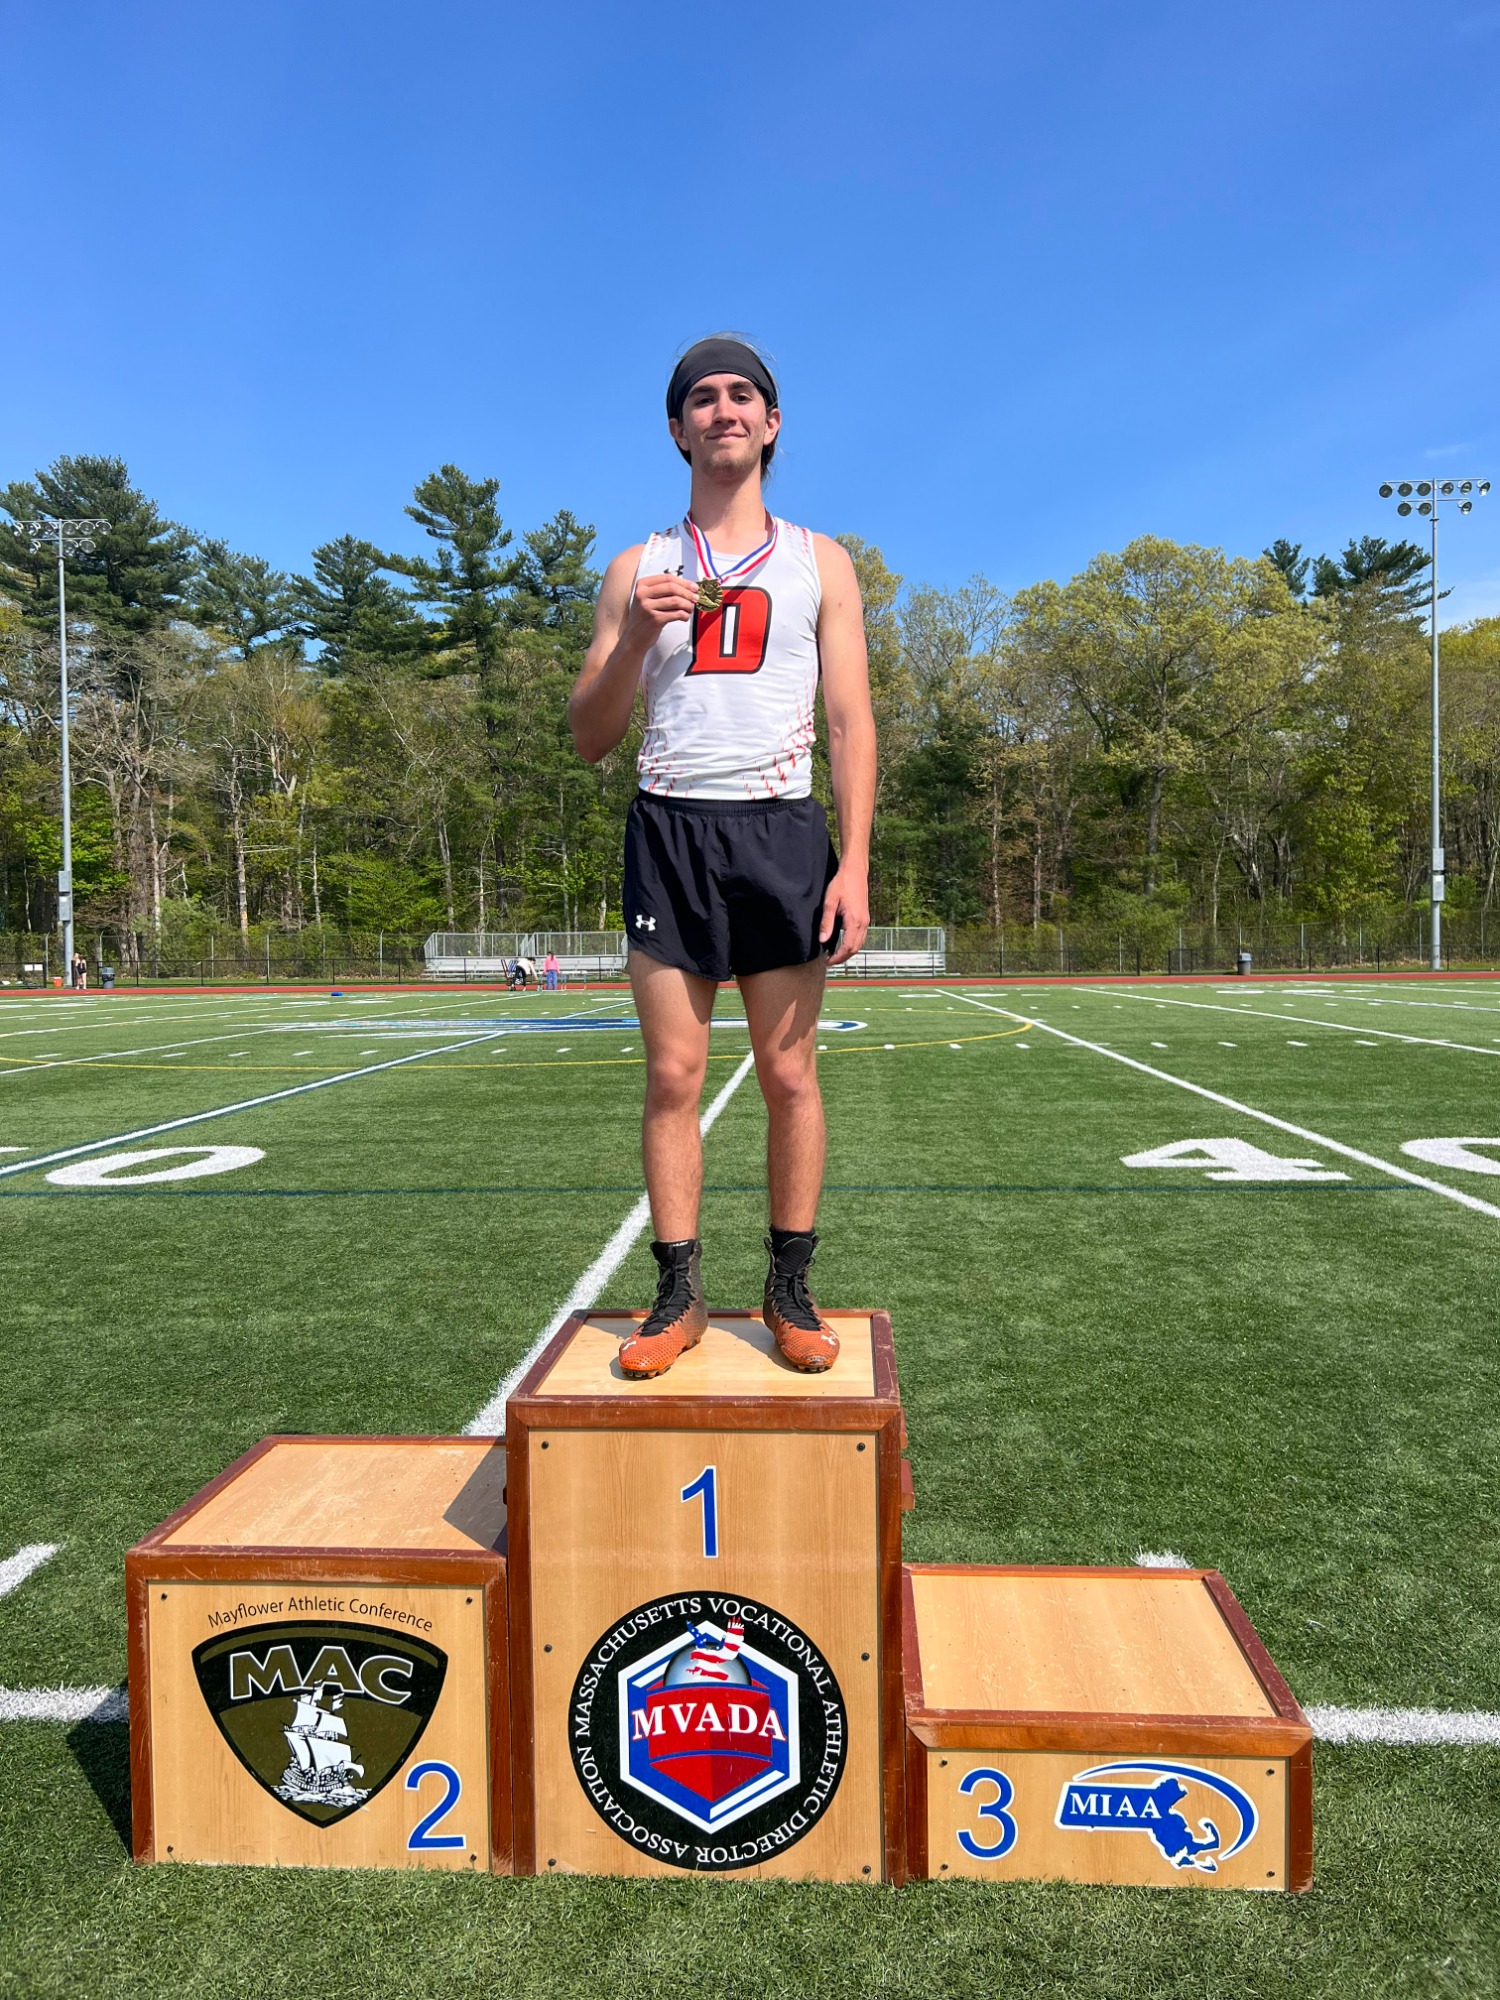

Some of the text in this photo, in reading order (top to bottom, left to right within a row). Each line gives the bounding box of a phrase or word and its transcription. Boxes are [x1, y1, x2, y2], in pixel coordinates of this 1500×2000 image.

[684, 586, 772, 677] D
[681, 1465, 718, 1558] 1
[208, 1595, 433, 1632] Mayflower Athletic Conference
[230, 1645, 413, 1704] MAC
[575, 1597, 842, 1864] MASSACHUSETTS VOCATIONAL ATHLETIC DIRECTOR ASSOCIATION
[632, 1702, 787, 1742] MVADA
[405, 1760, 466, 1850] 2
[957, 1768, 1017, 1860] 3
[1069, 1792, 1162, 1820] MIAA
